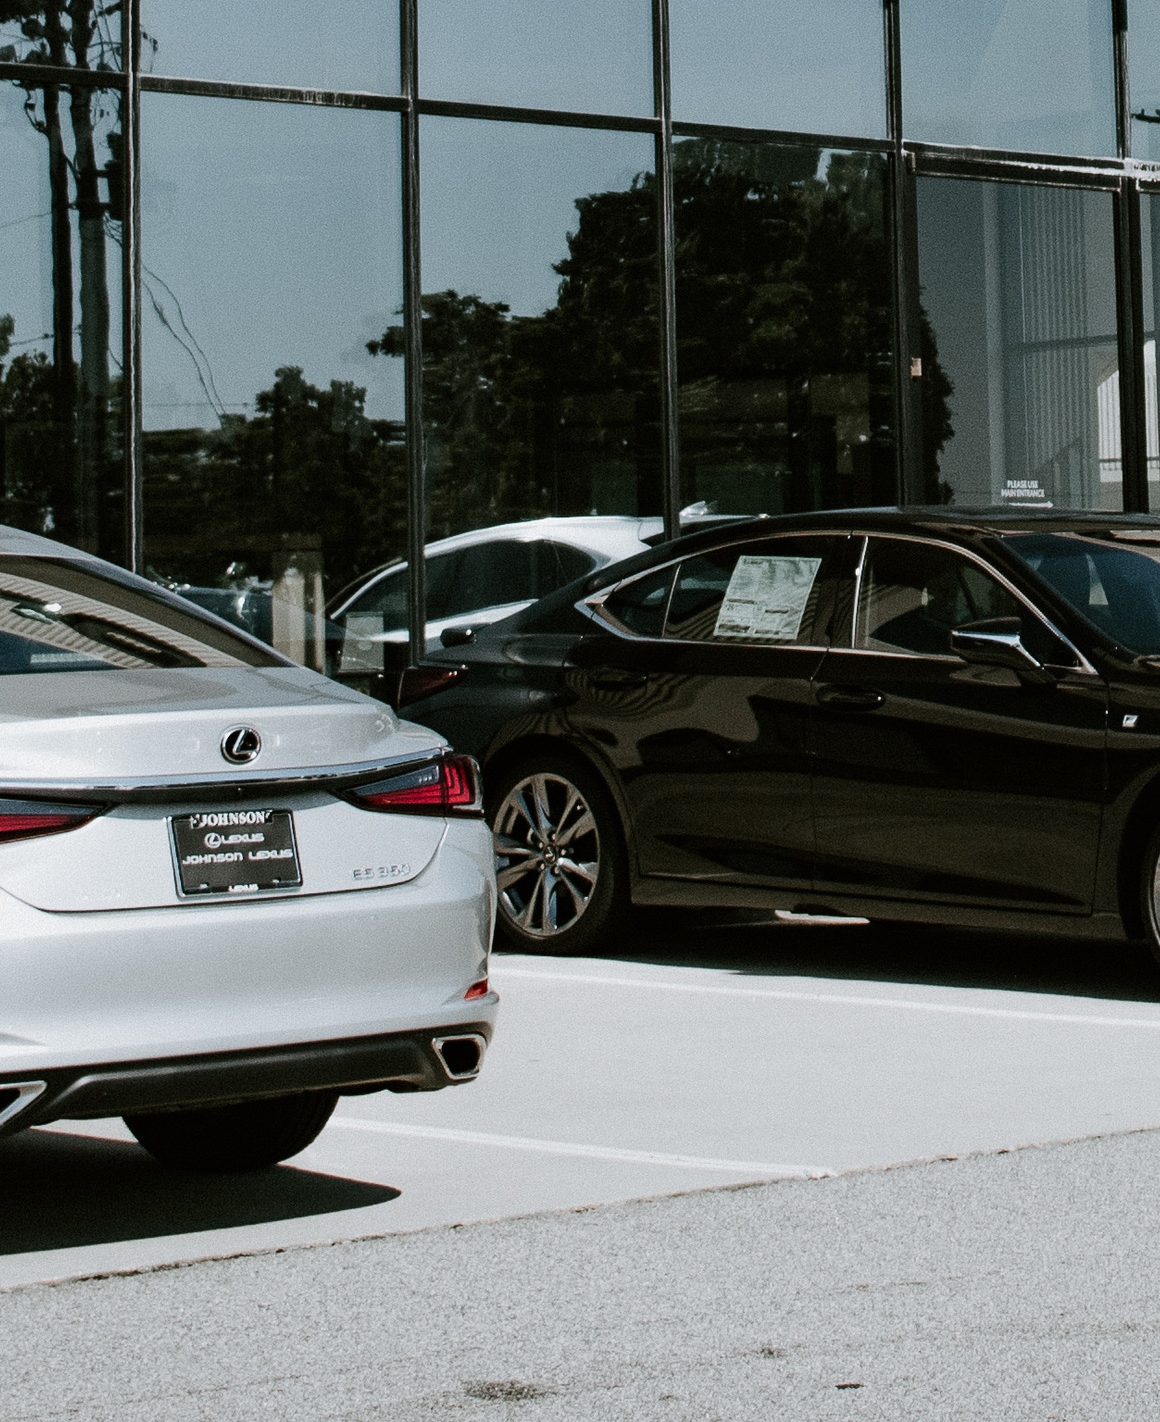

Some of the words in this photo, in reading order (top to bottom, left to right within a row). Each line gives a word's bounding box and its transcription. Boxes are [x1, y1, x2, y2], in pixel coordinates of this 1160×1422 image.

[1007, 480, 1027, 489] PLEASE
[1001, 488, 1017, 498] MAIN
[1017, 489, 1045, 498] ENTRANCE
[199, 810, 266, 828] JOHNSON
[221, 832, 265, 845] LEXUS
[248, 848, 293, 861] LEXUS
[378, 863, 411, 879] 350
[228, 883, 259, 893] LEXUS
